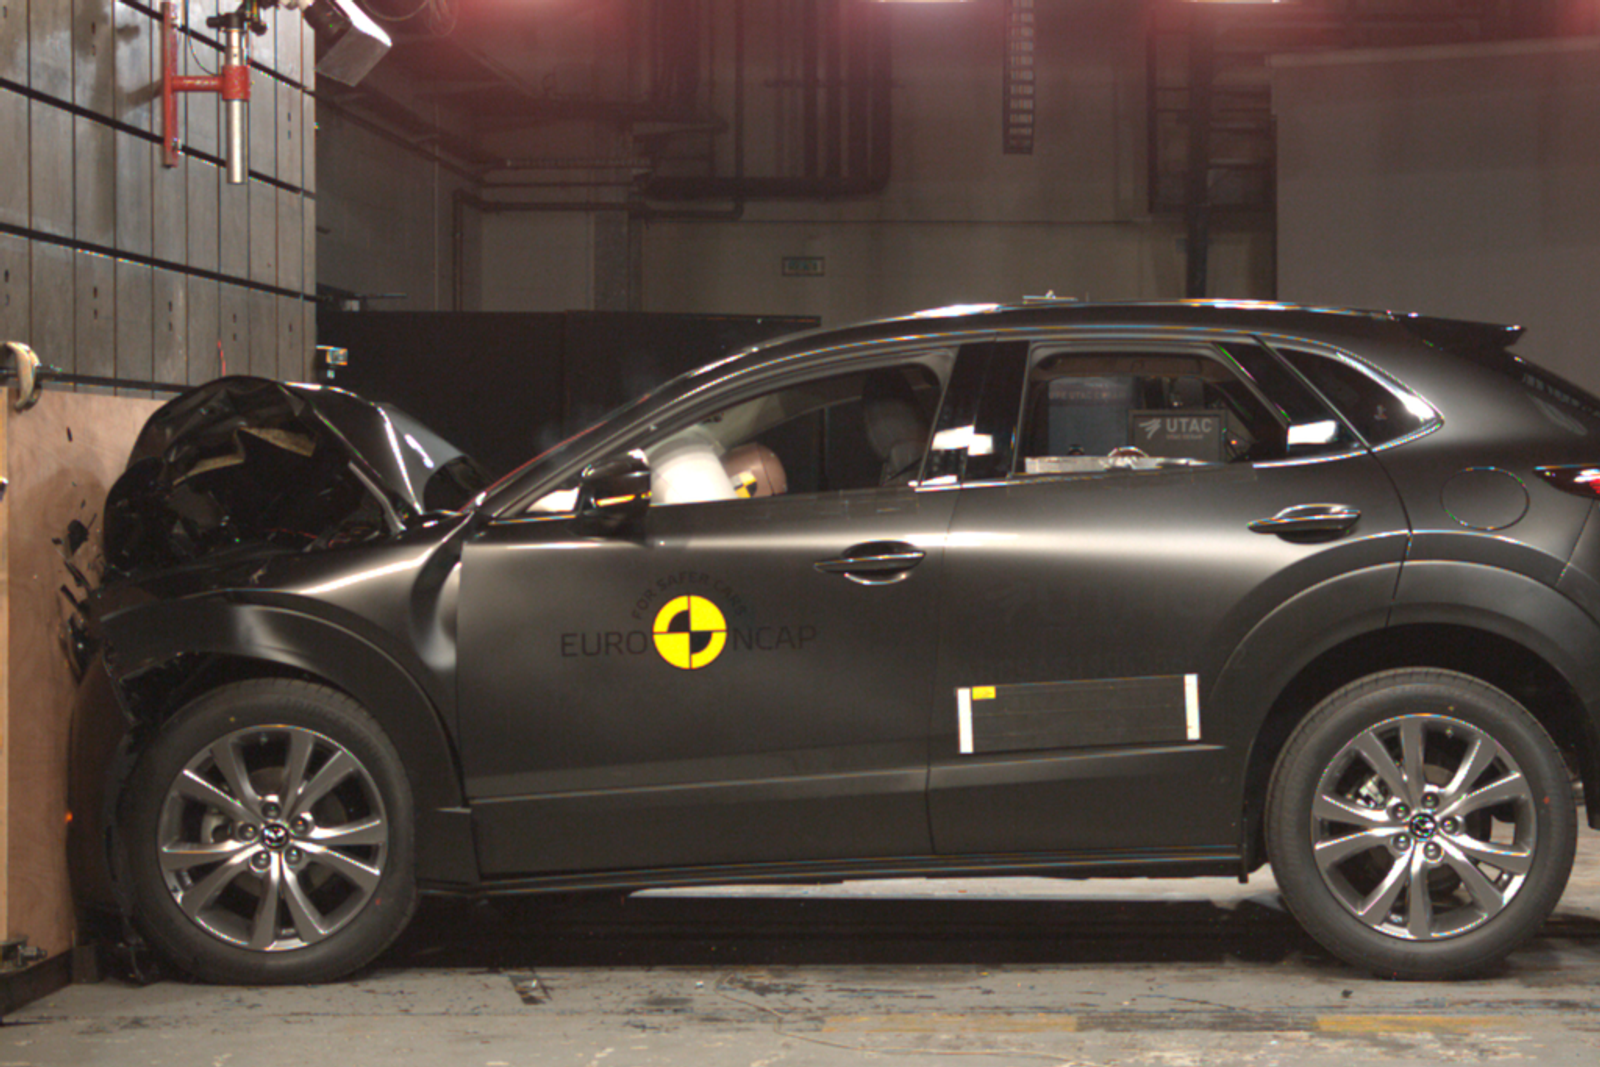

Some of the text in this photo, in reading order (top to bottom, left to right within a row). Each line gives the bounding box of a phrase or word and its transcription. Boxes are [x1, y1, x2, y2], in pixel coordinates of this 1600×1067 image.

[1166, 417, 1212, 433] UTAC
[631, 570, 748, 620] FOR SAFER CARS
[561, 625, 818, 657] EURO NCAP
